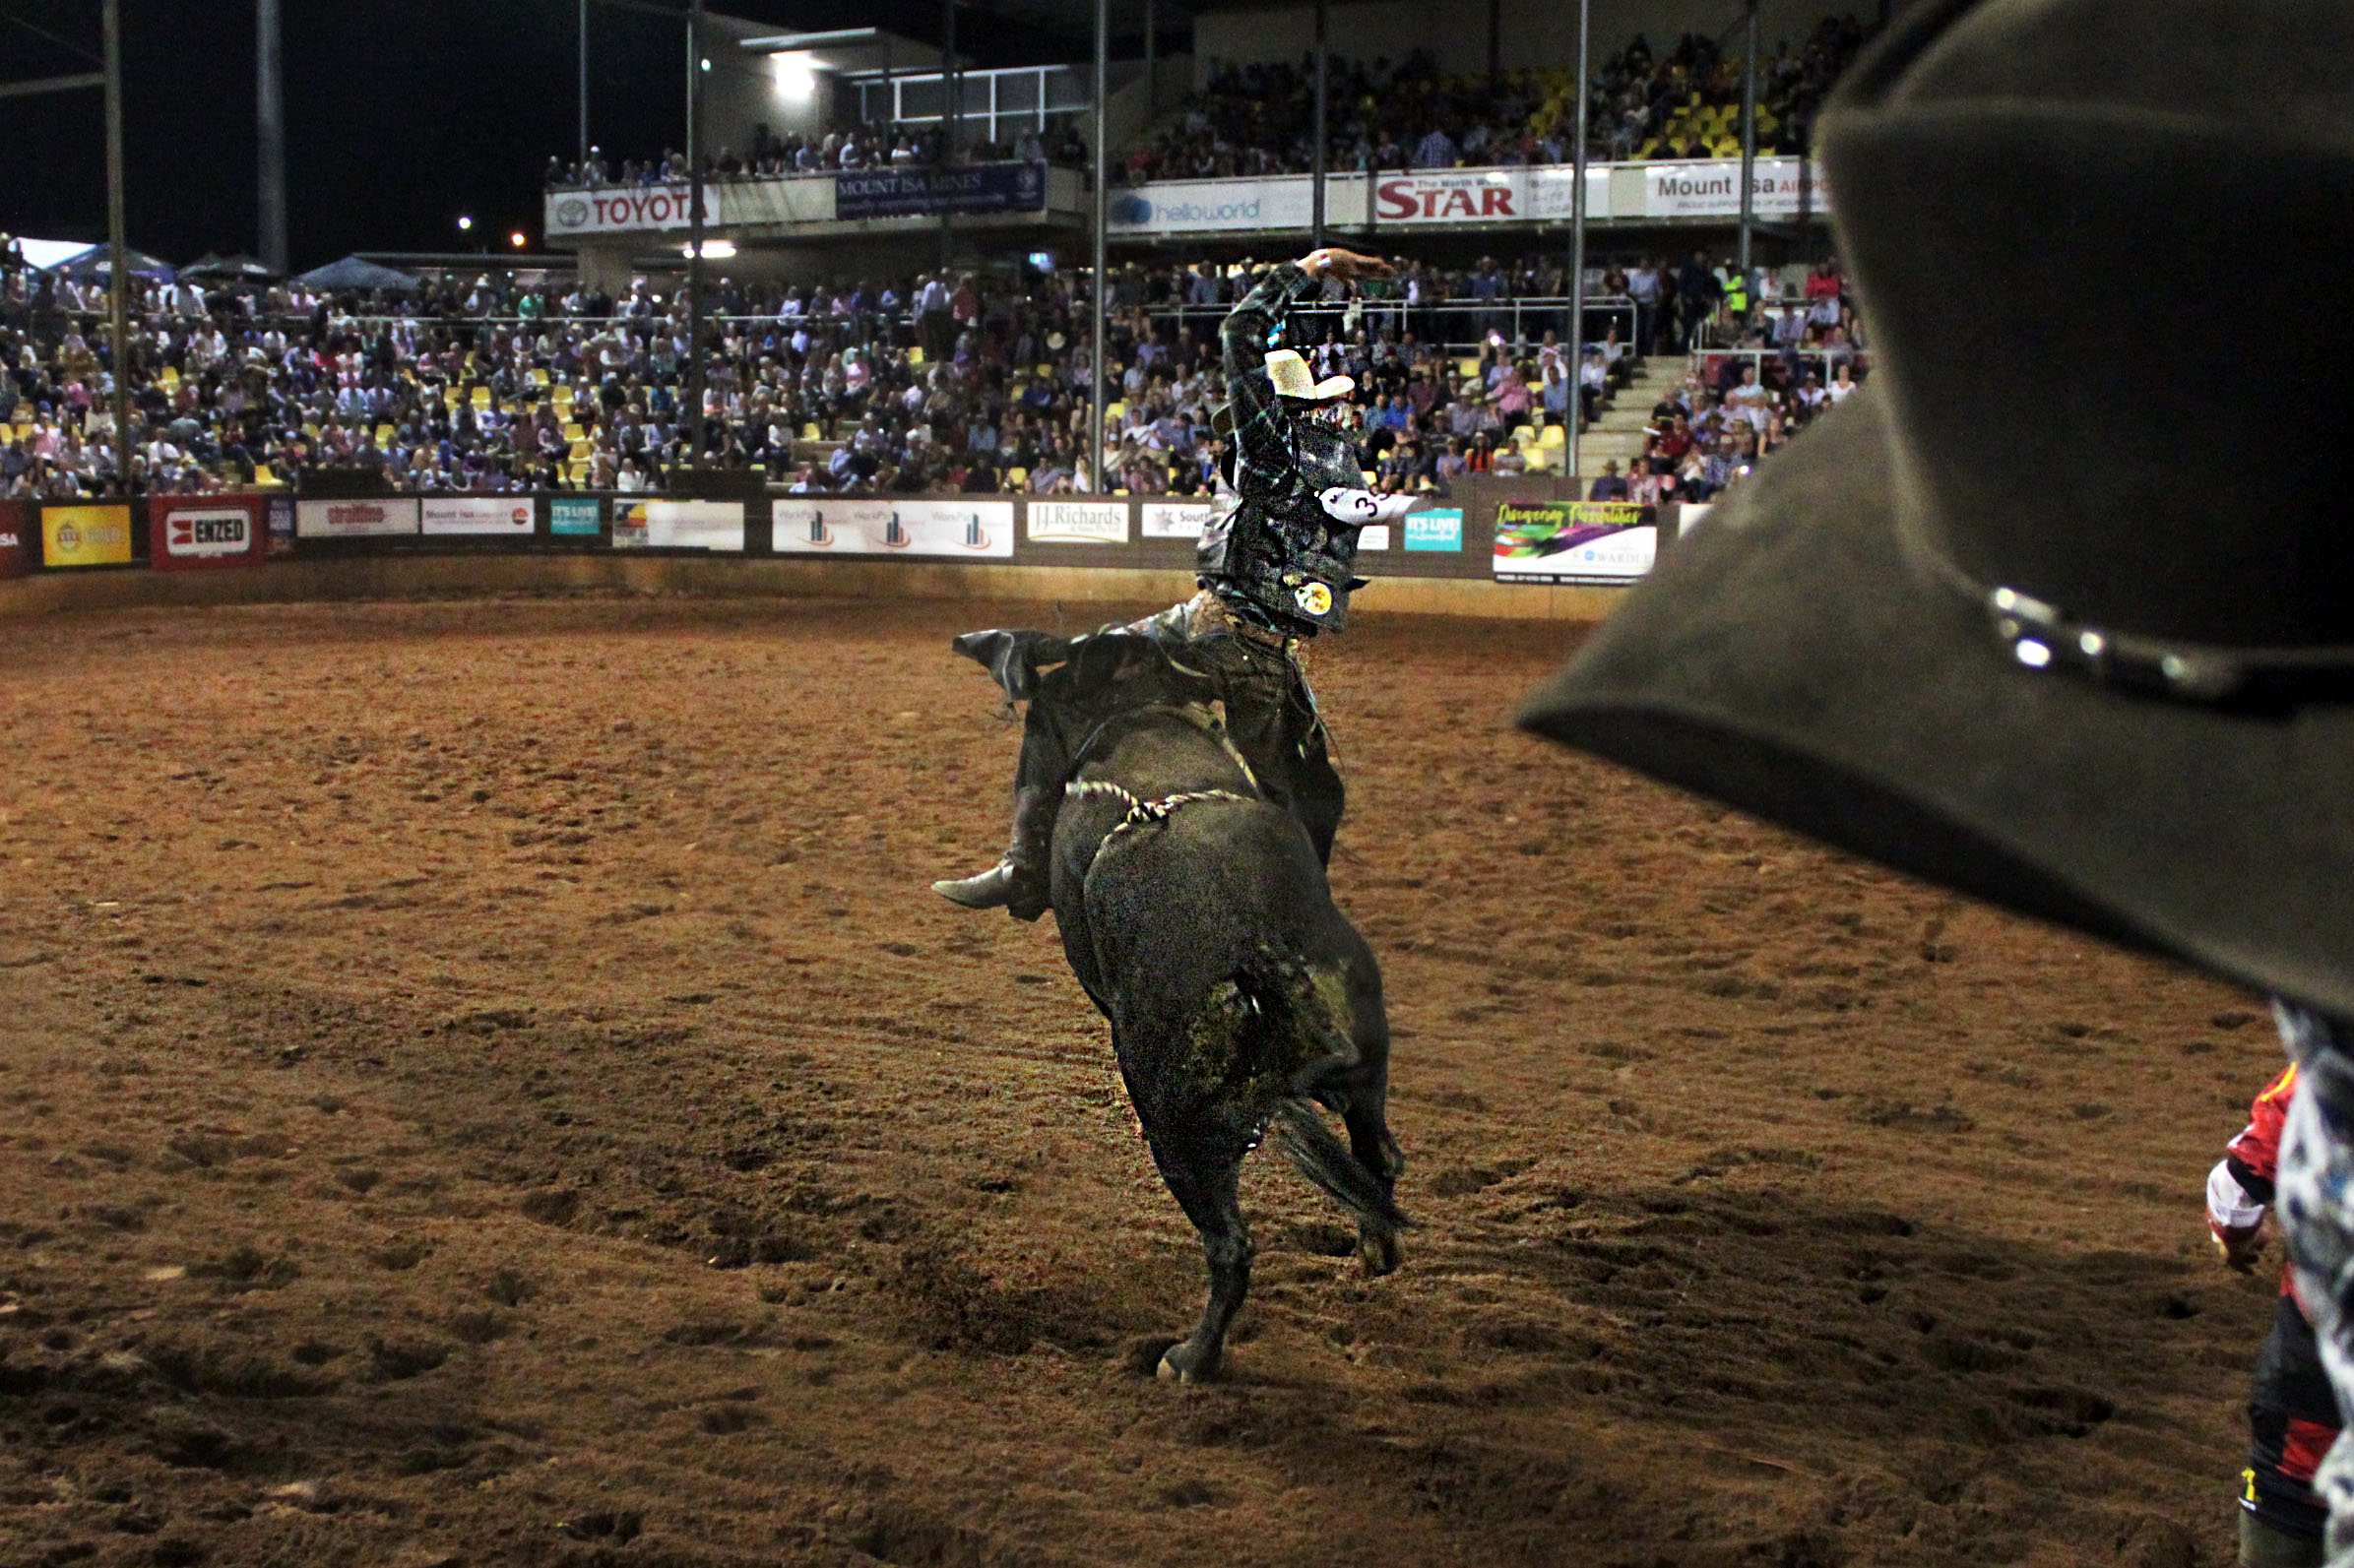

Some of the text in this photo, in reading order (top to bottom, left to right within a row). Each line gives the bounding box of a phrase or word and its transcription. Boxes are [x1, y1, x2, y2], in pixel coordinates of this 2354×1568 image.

[838, 176, 897, 196] MOUNT
[901, 175, 926, 193] ISA
[1657, 175, 1732, 197] Mount
[1154, 199, 1261, 222] helloworld
[1376, 179, 1516, 220] STAR
[195, 519, 245, 543] ENZED
